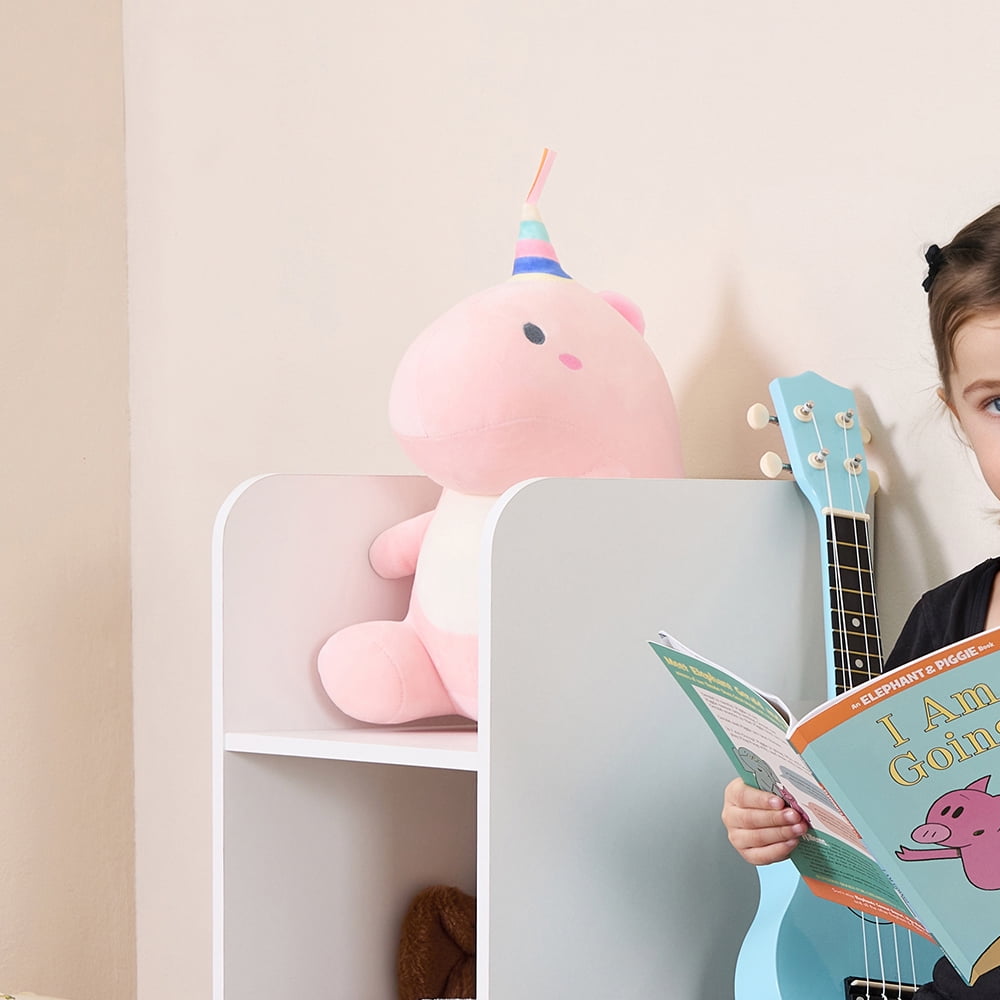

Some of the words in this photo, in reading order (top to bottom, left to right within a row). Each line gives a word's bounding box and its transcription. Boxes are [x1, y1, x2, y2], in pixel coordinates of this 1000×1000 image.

[851, 702, 861, 710] An
[859, 667, 926, 706] ELEPHANT
[925, 665, 936, 675] &
[934, 646, 980, 671] PIGGIE
[978, 642, 995, 653] Book
[876, 713, 910, 748] I
